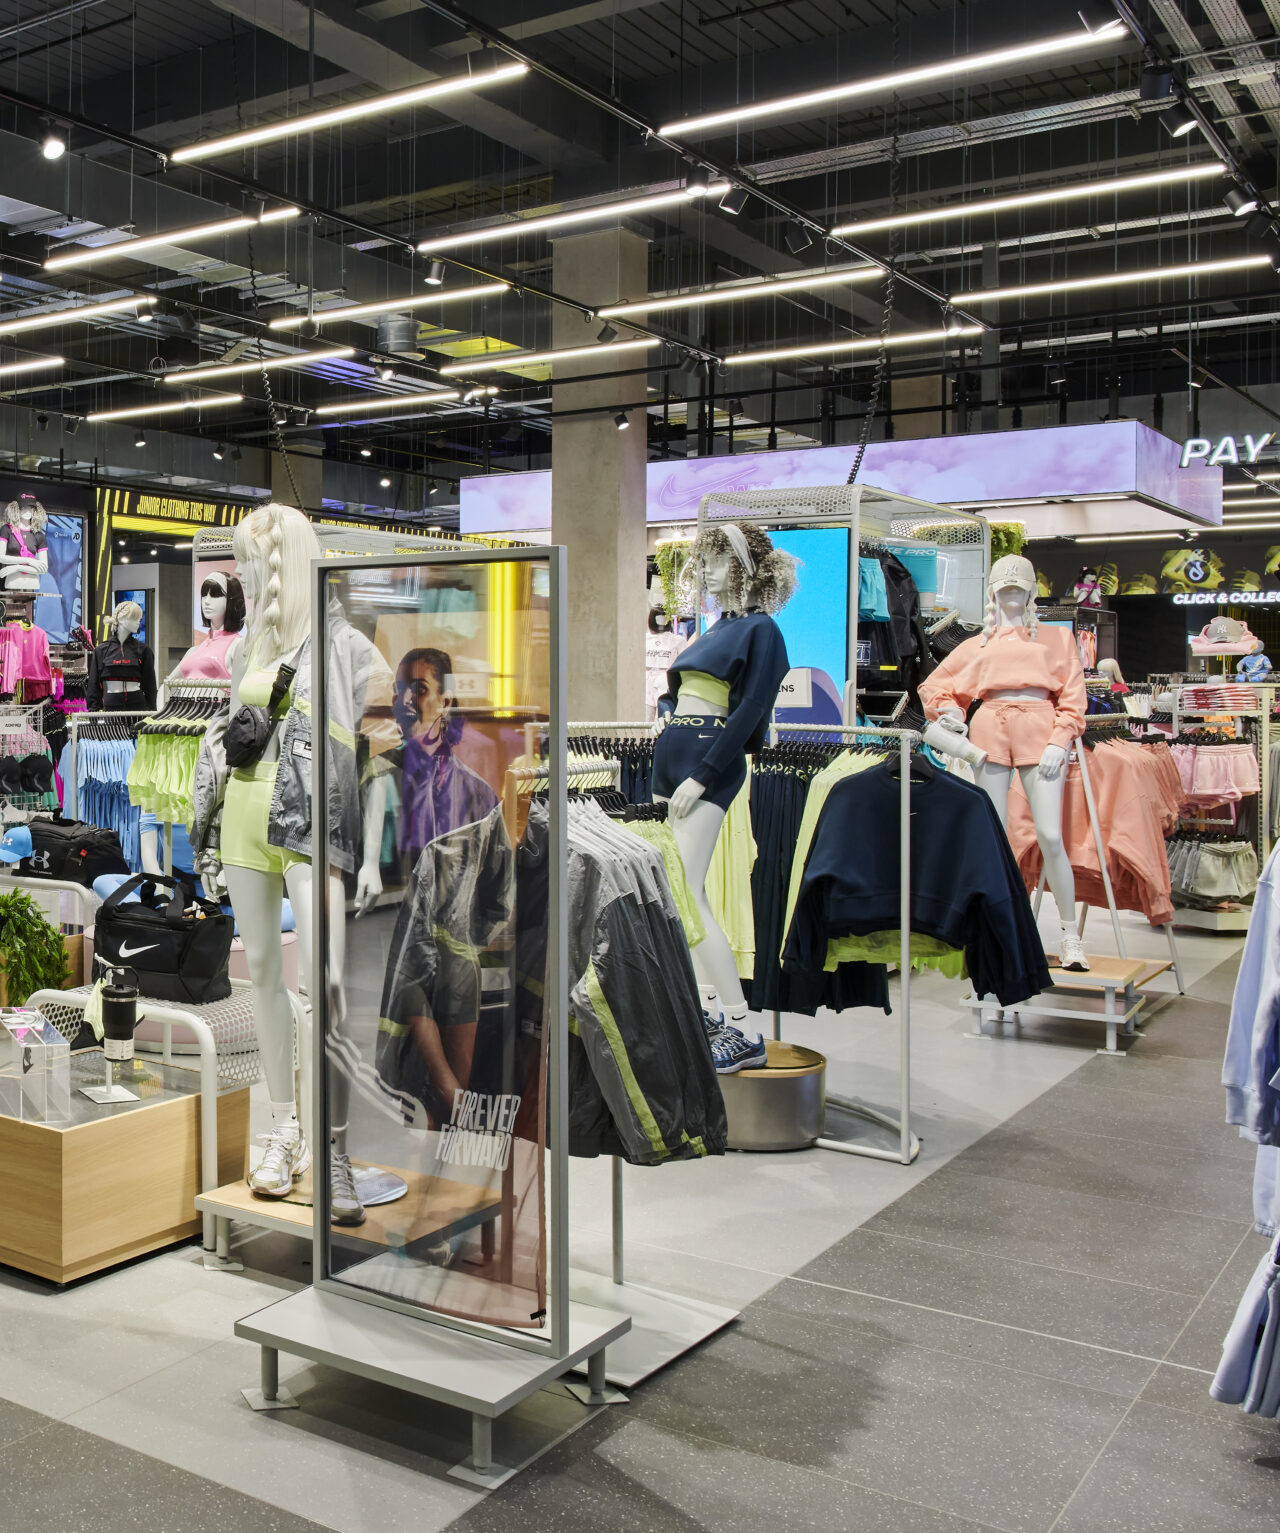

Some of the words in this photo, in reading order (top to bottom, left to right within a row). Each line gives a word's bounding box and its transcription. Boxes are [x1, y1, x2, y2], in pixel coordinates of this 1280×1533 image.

[1179, 433, 1271, 467] PAY
[137, 495, 161, 516] JUNIOR
[160, 498, 190, 520] CLOTHING
[189, 502, 203, 521] THIS
[203, 504, 217, 522] WAY
[1173, 594, 1217, 604] CLICK
[1217, 593, 1229, 603] &
[669, 717, 705, 727] PRO
[450, 1088, 521, 1134] FOREVER
[435, 1123, 512, 1171] FORWARD
